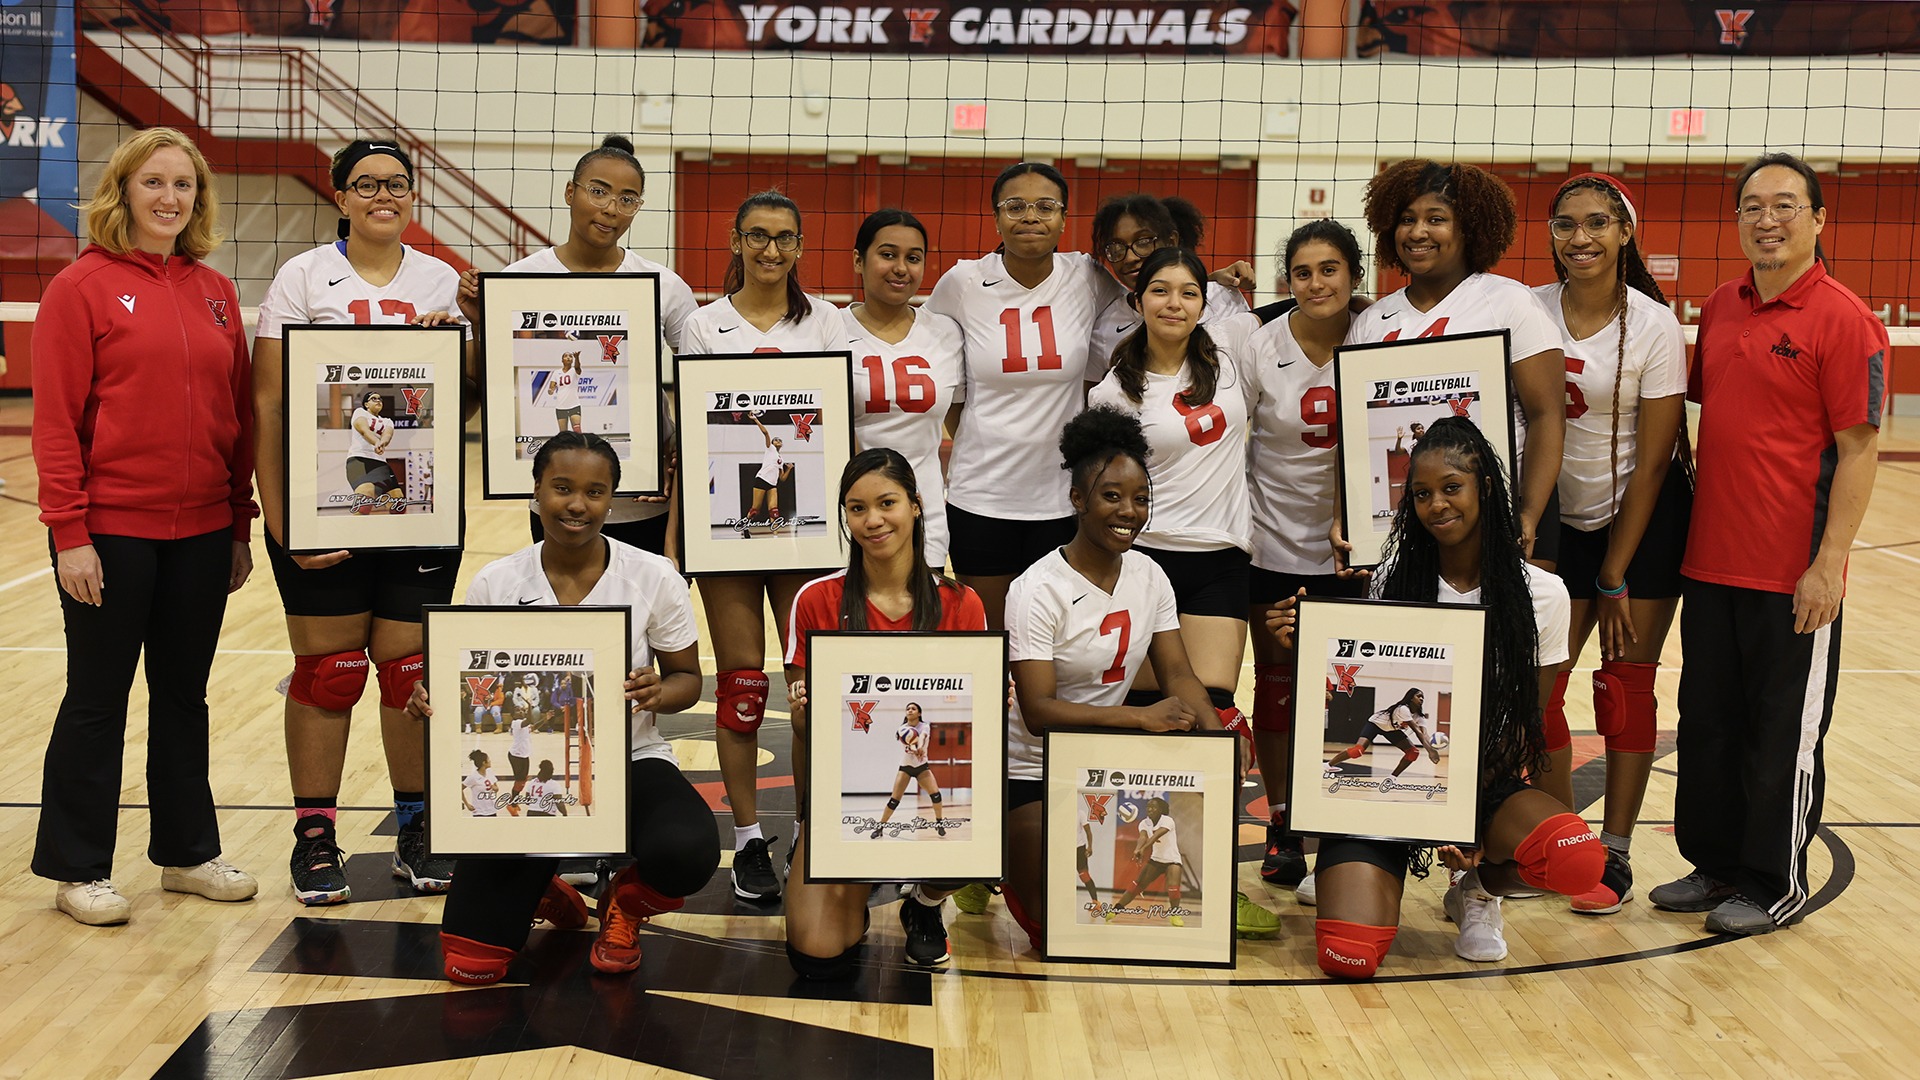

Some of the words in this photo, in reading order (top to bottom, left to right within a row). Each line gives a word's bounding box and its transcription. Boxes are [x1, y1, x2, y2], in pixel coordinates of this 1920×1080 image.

[0, 11, 26, 26] ion
[739, 5, 893, 43] YORK
[950, 7, 1251, 45] CARDINALS
[0, 116, 67, 147] RK
[560, 315, 621, 326] VOLLEYBALL
[1000, 306, 1062, 373] 11
[365, 368, 426, 379] VOLLEYBALL
[862, 355, 936, 413] 16
[1411, 377, 1472, 393] VOLLEYBALL
[753, 394, 814, 406] VOLLEYBALL
[1301, 386, 1338, 449] 9
[1099, 609, 1131, 684] 7
[1379, 645, 1445, 659] VOLLEYBALL
[336, 659, 368, 668] macron
[514, 654, 584, 666] VOLLEYBALL
[402, 662, 423, 672] mac
[735, 677, 768, 687] macron
[895, 678, 964, 690] VOLLEYBALL
[1129, 774, 1195, 787] VOLLEYBALL
[842, 816, 861, 824] #12
[1084, 902, 1097, 910] #7
[1326, 948, 1366, 966] macron
[452, 966, 494, 980] macron
